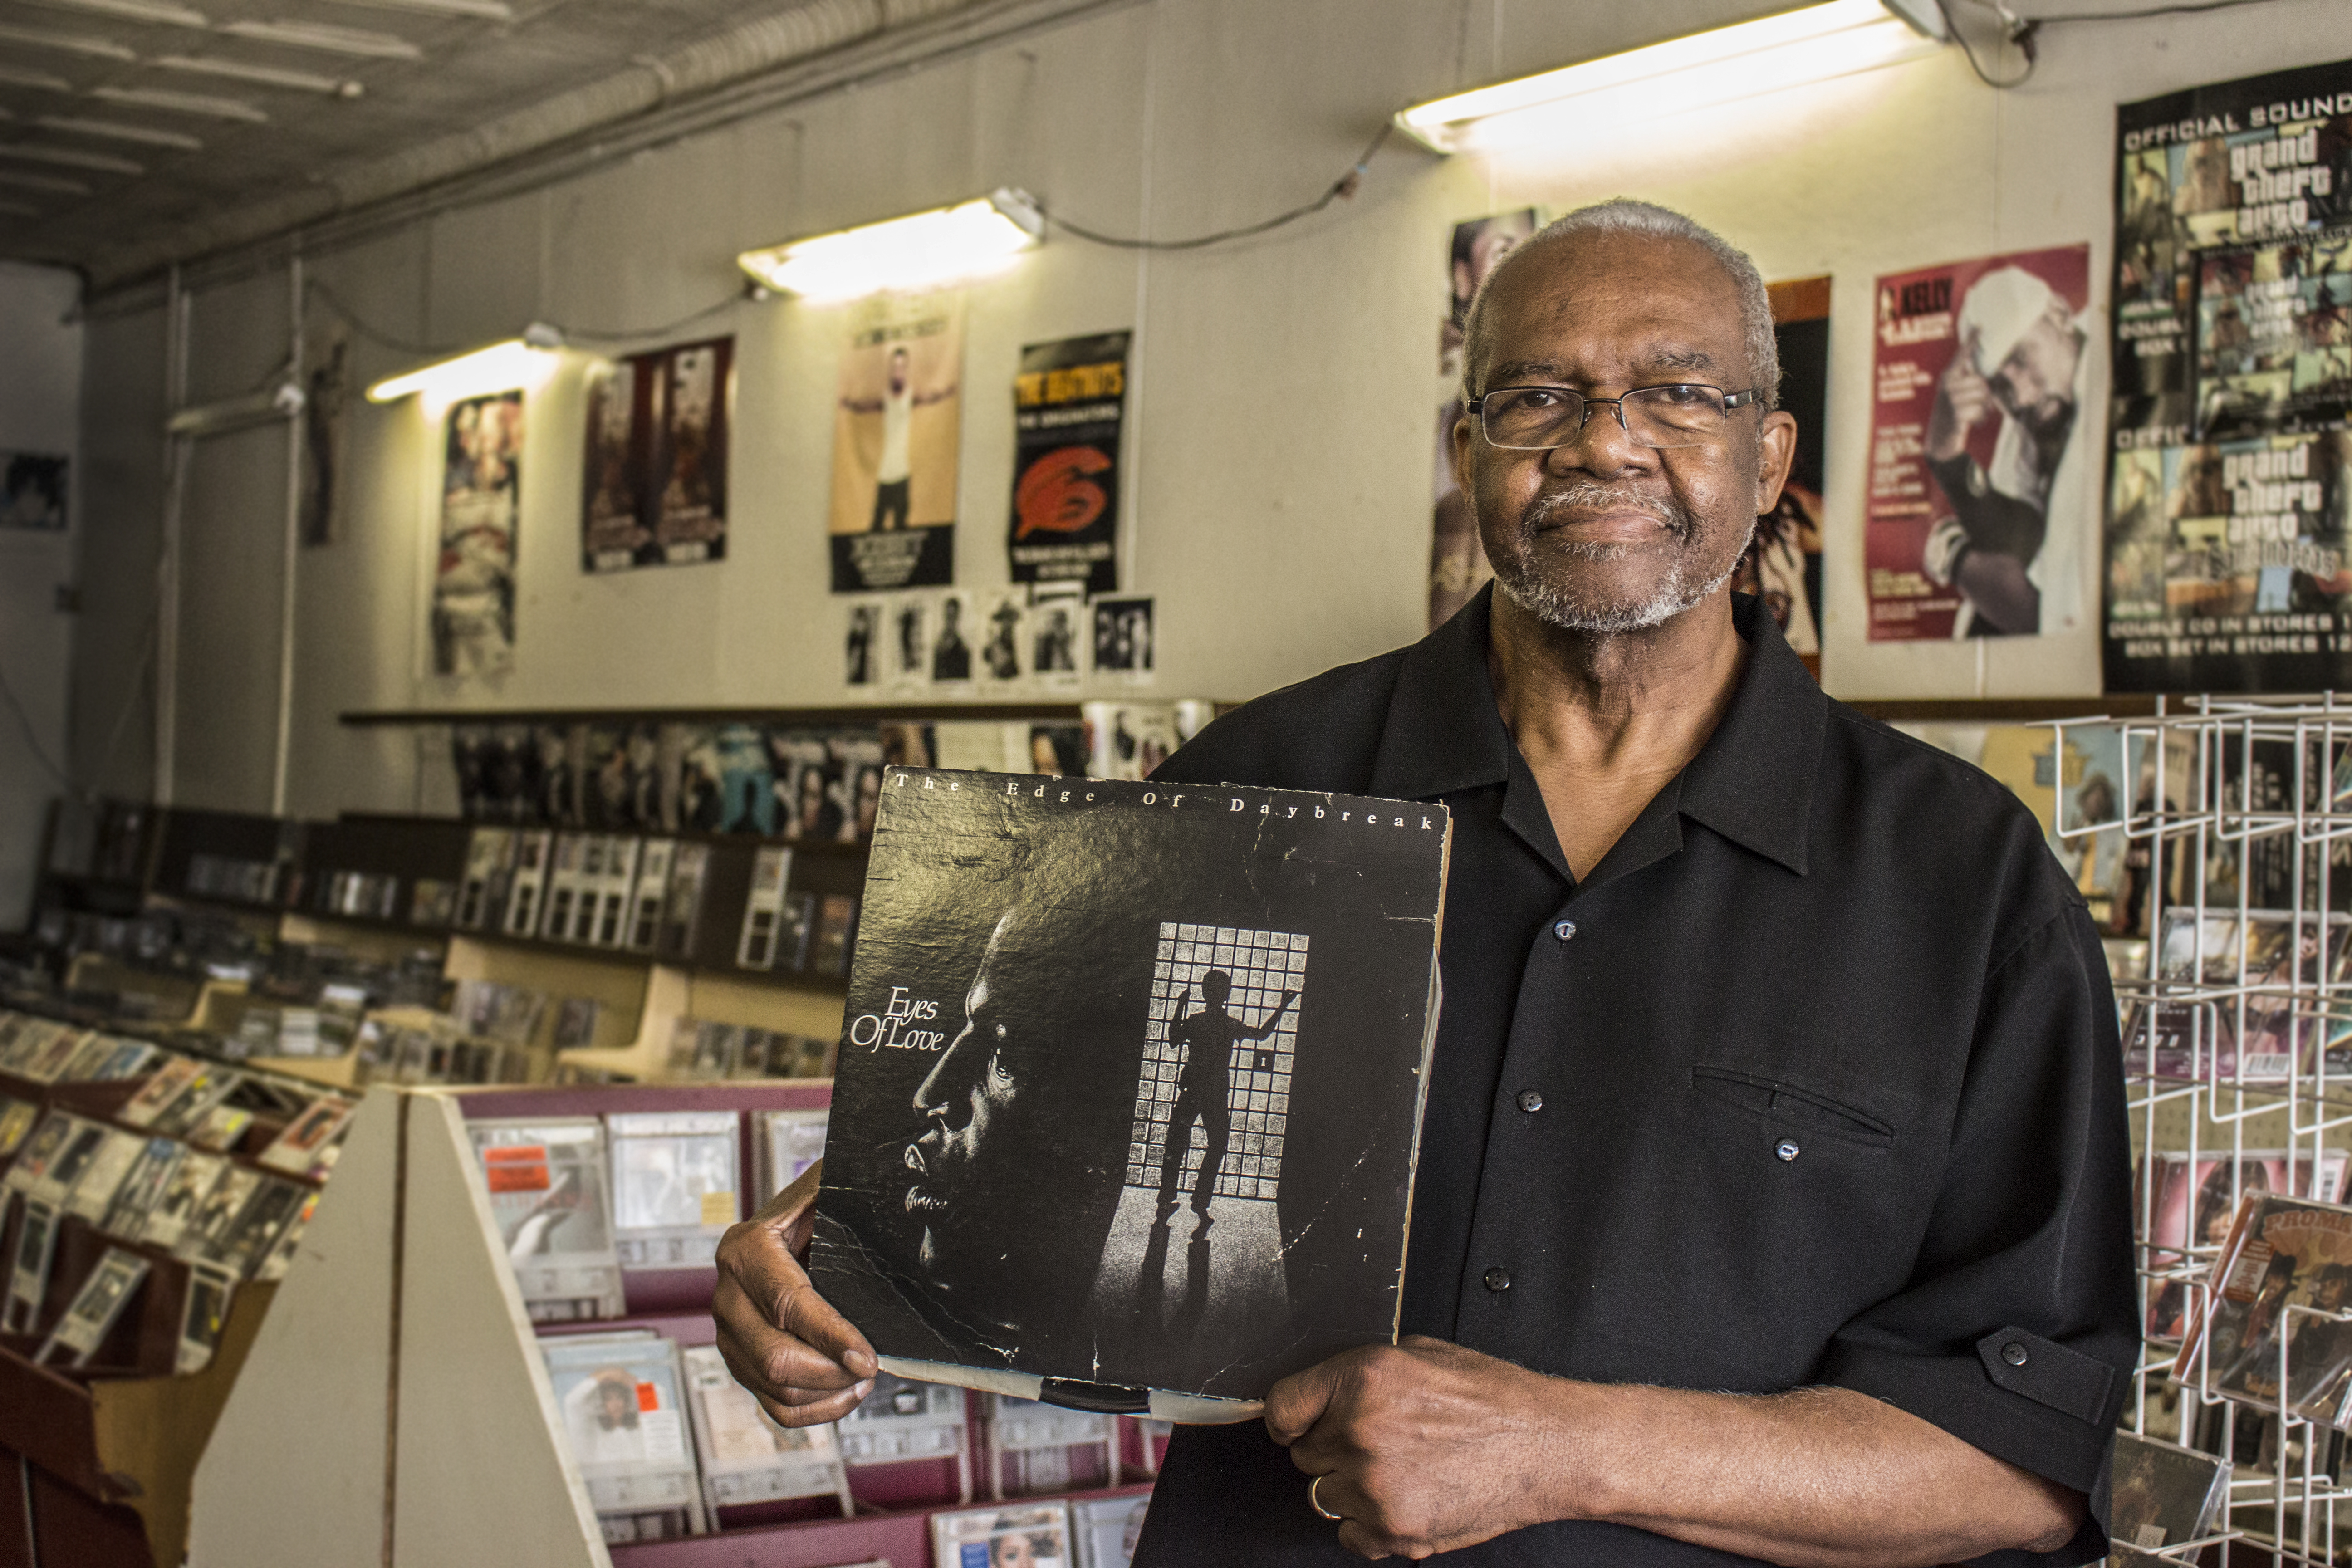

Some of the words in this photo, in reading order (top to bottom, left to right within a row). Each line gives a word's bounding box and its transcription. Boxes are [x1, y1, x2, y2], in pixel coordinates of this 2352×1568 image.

[2124, 112, 2240, 152] OFFICIAL
[2249, 92, 2352, 128] SOUND
[2109, 618, 2185, 639] DOUBLE
[2221, 616, 2242, 634] IN
[2248, 613, 2333, 633] STORES
[2167, 638, 2204, 657] SET
[2207, 637, 2229, 656] IN
[2234, 634, 2319, 655] STORES
[896, 773, 959, 791] The
[1006, 782, 1095, 802] Edge
[1142, 792, 1184, 808] Of
[1230, 799, 1431, 830] Daybreak
[884, 986, 939, 1026] Eyes
